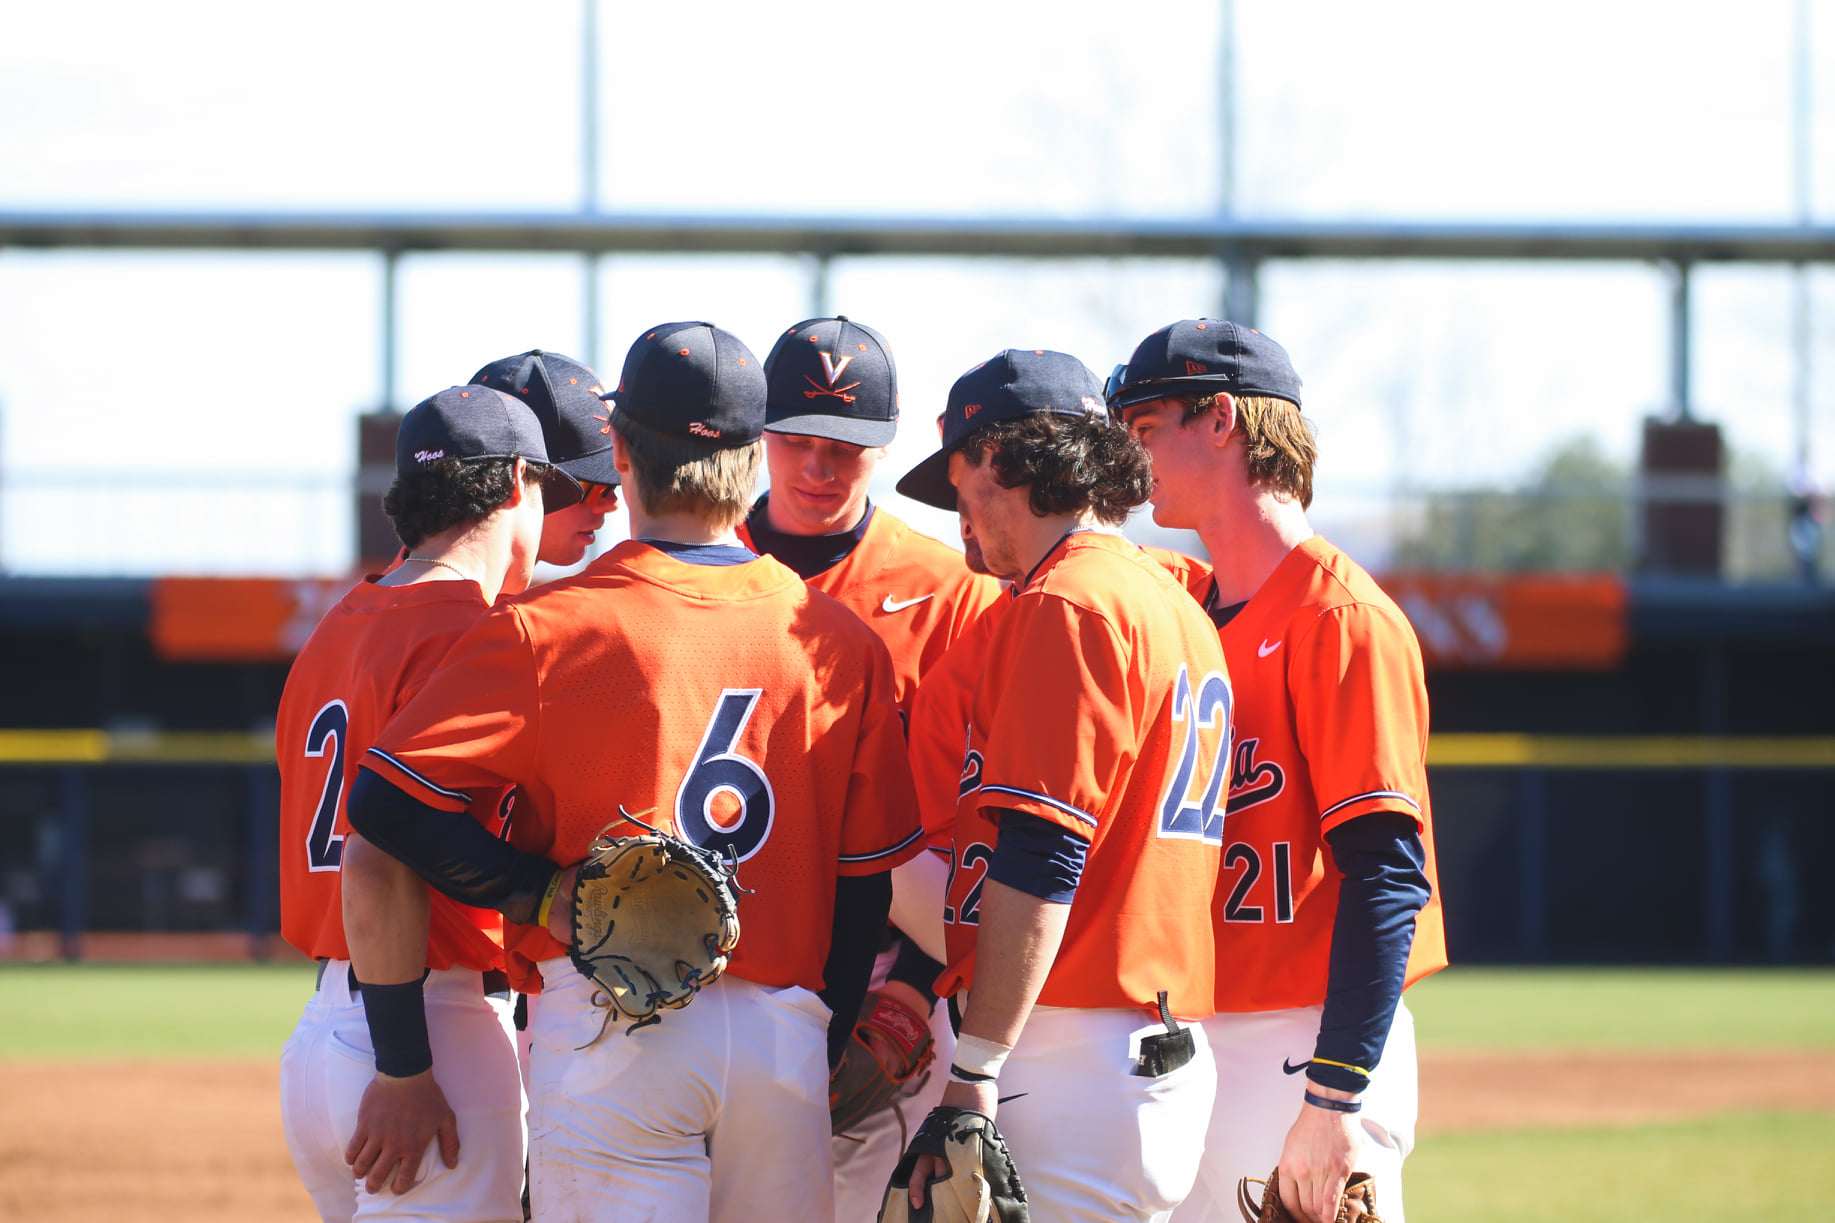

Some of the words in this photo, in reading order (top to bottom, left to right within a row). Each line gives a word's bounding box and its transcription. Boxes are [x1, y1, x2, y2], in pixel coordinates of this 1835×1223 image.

[818, 351, 855, 388] V
[414, 449, 445, 464] Hoos
[689, 421, 722, 439] Hoos
[304, 699, 350, 873] 2
[674, 688, 776, 866] 6
[1157, 662, 1234, 846] 22
[1224, 842, 1294, 923] 21
